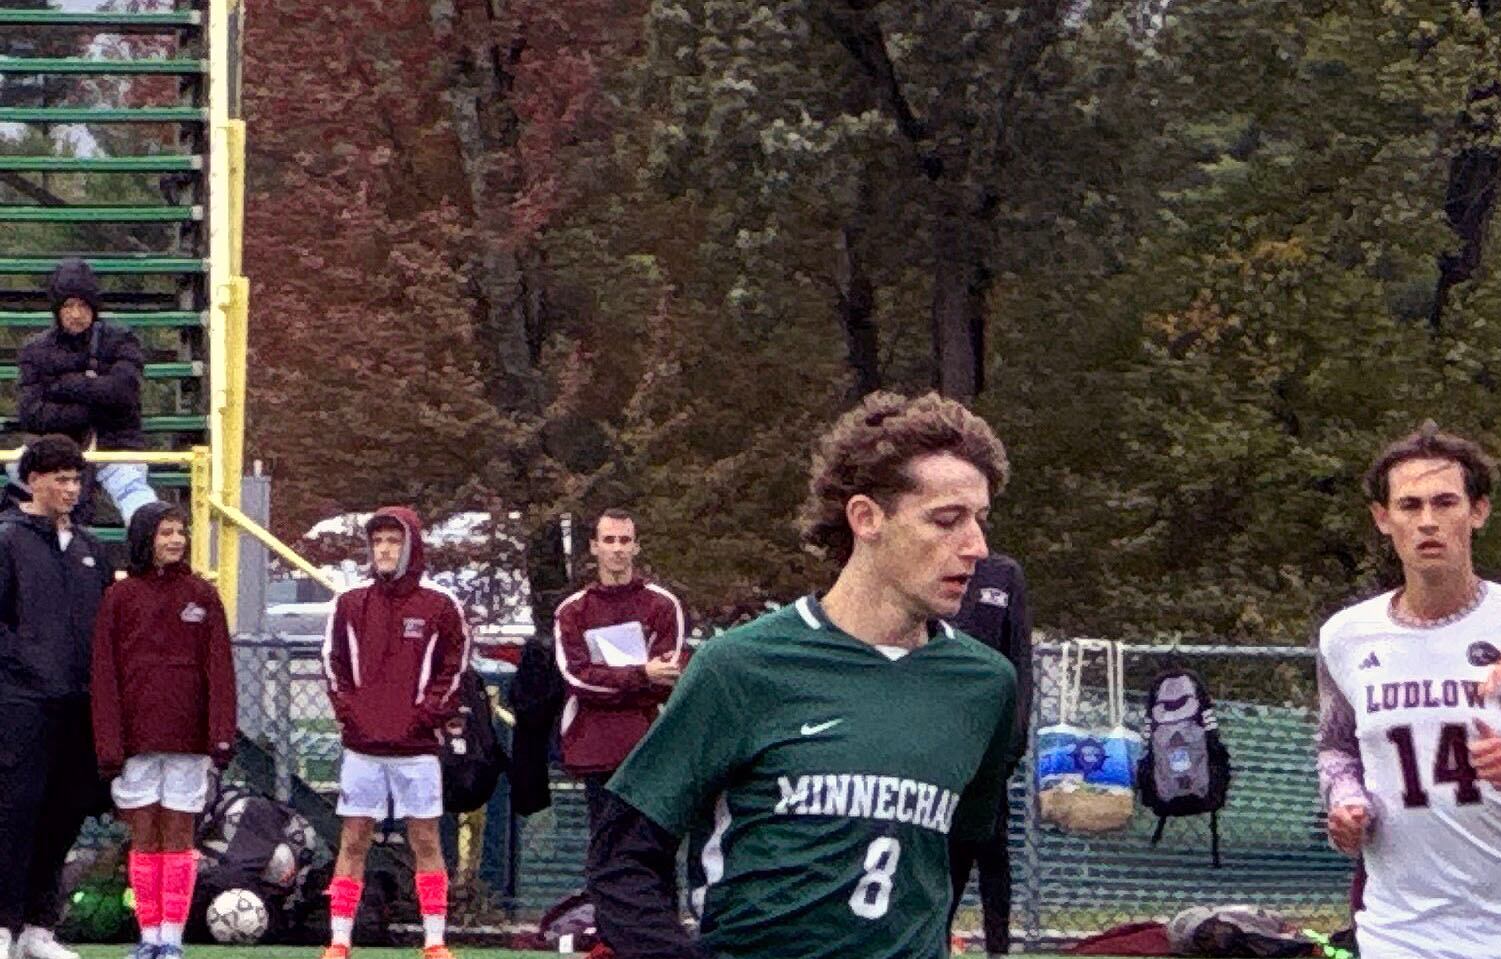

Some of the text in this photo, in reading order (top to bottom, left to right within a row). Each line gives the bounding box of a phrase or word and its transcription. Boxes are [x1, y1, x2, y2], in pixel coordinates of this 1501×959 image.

[1365, 679, 1486, 713] LUDLOW
[1386, 721, 1483, 808] 14
[848, 836, 901, 919] 8
